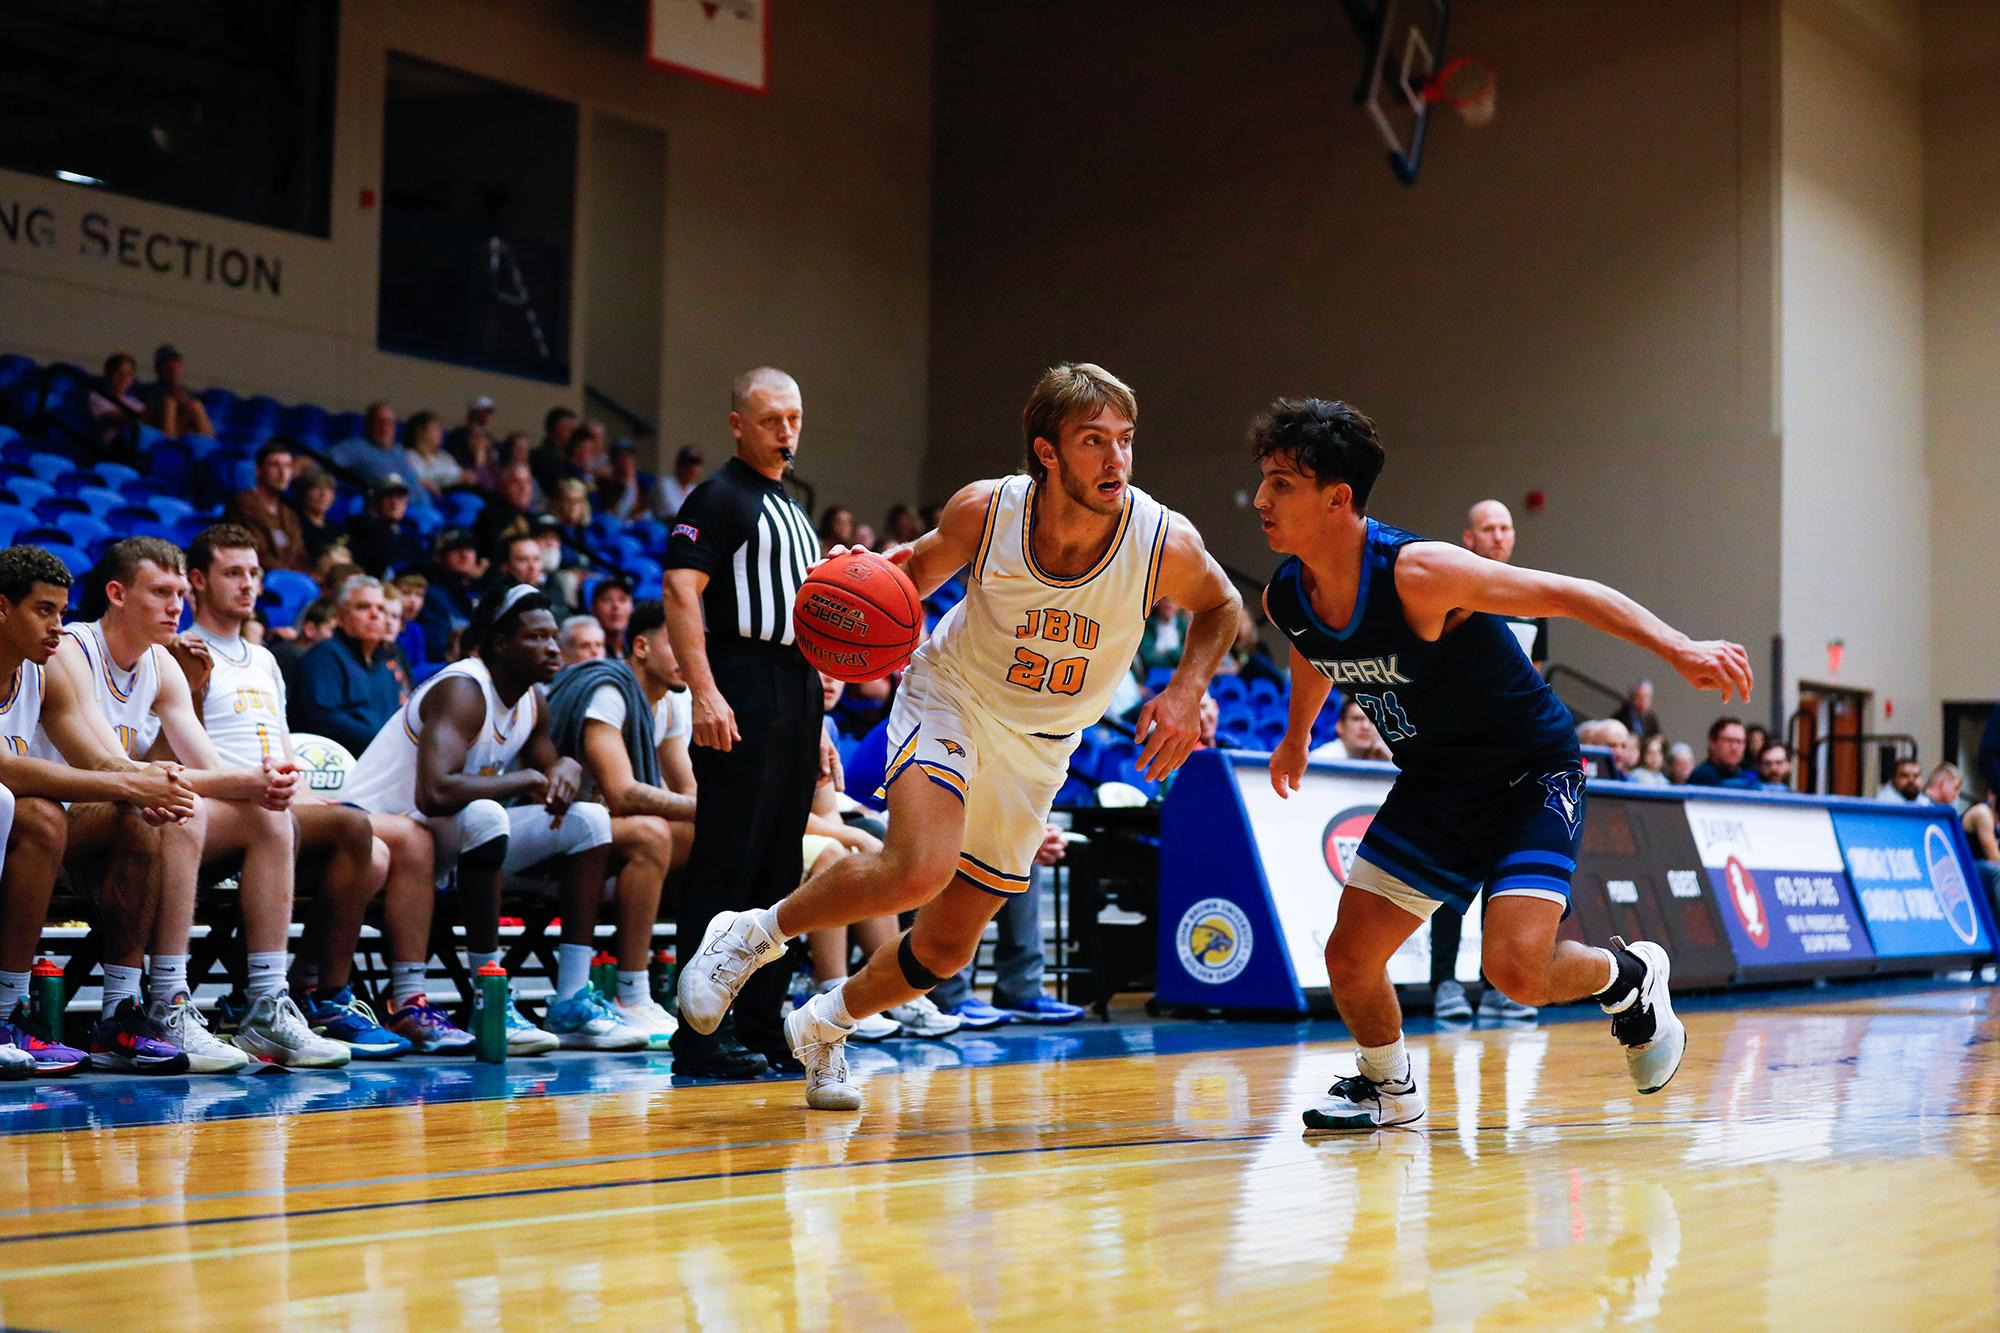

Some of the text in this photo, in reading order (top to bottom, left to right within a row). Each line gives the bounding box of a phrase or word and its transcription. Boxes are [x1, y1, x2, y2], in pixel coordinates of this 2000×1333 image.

[80, 212, 283, 295] SECTION
[801, 602, 868, 637] LEGACY
[1015, 608, 1100, 651] JBU
[1006, 646, 1090, 697] 20
